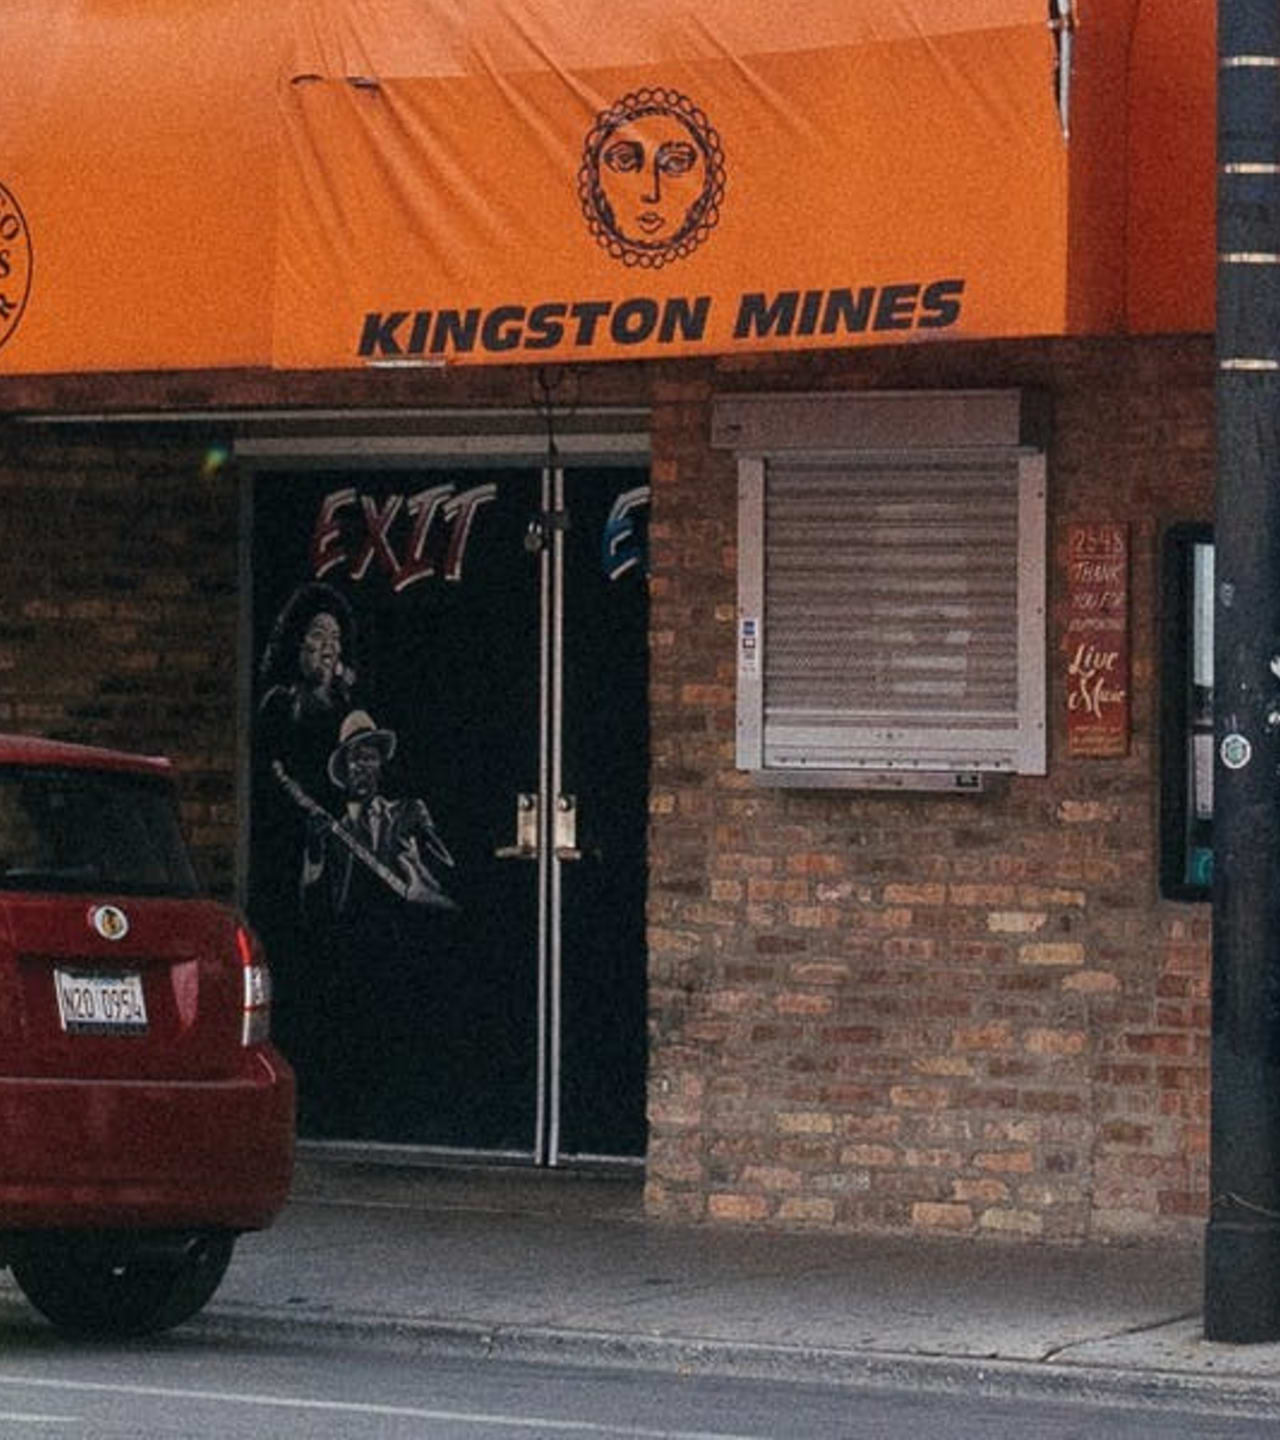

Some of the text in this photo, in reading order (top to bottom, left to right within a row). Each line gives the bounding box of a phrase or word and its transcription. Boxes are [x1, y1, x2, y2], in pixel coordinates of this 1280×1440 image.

[357, 279, 965, 357] KINGSTON MINES
[312, 482, 498, 593] EXIT
